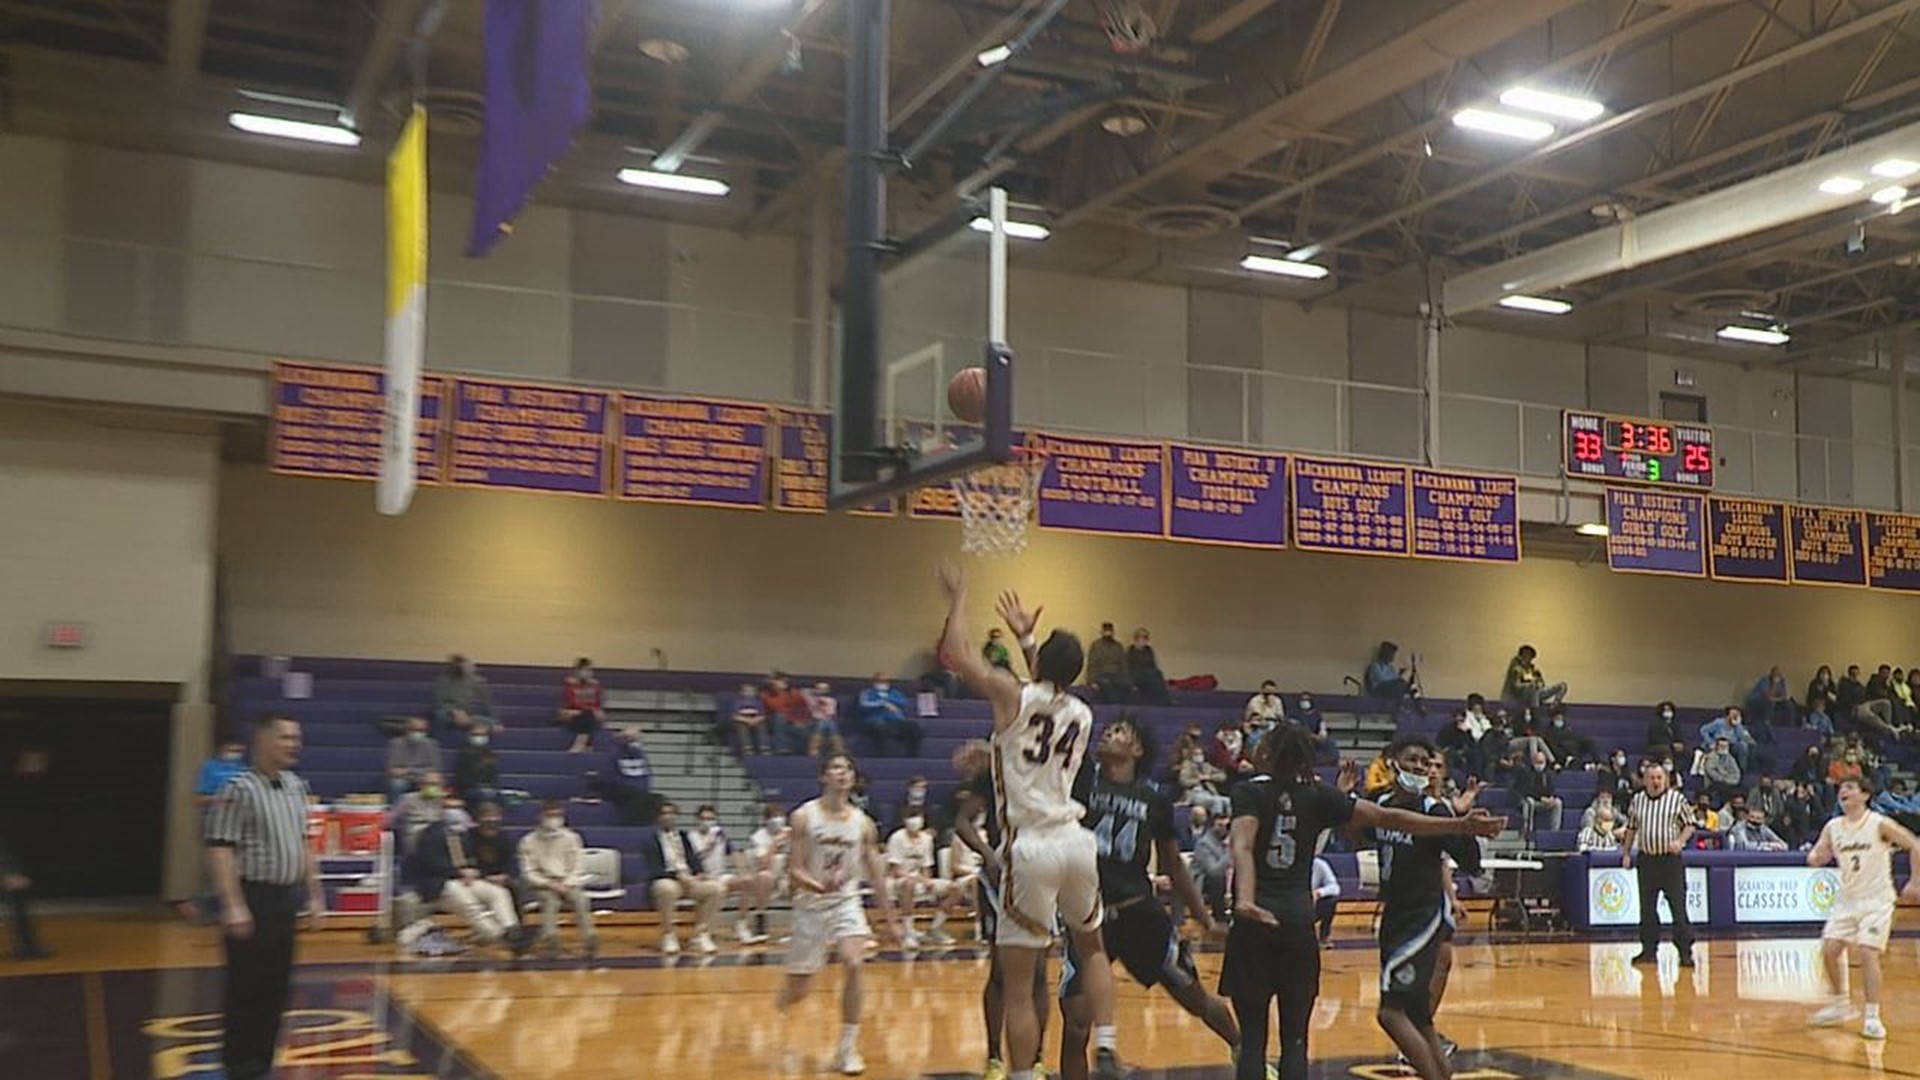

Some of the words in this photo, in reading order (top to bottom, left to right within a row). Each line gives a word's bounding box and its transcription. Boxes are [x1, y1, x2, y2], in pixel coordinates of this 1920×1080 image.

[1571, 416, 1599, 430] HOME
[1676, 428, 1711, 442] VISITOR
[1578, 433, 1602, 461] 33
[1684, 445, 1710, 470] 25
[1056, 458, 1146, 478] CHAMPIONS
[1647, 459, 1661, 481] 3
[1060, 474, 1142, 494] FOOTBALL
[1188, 467, 1270, 489] CHAMPIONS
[1201, 485, 1256, 504] FOOTBALL
[1312, 479, 1391, 499] CHAMPIONS
[1355, 498, 1381, 514] GOLF
[1429, 490, 1501, 509] CHAMPIONS
[1642, 494, 1682, 511] DISTRICT
[1469, 508, 1493, 523] GOLF
[1622, 506, 1688, 525] CHAMPIONS
[1621, 521, 1656, 536] GIRLS
[1660, 524, 1689, 539] GOLF
[1725, 522, 1772, 537] CHAMPIONS
[1746, 535, 1777, 550] SOCCER
[1022, 712, 1081, 769] 34
[1094, 814, 1140, 864] 44
[1264, 814, 1298, 870] 5
[1737, 880, 1776, 892] SCRANTON
[1779, 880, 1799, 892] PREP
[1737, 892, 1799, 909] CLASSICS
